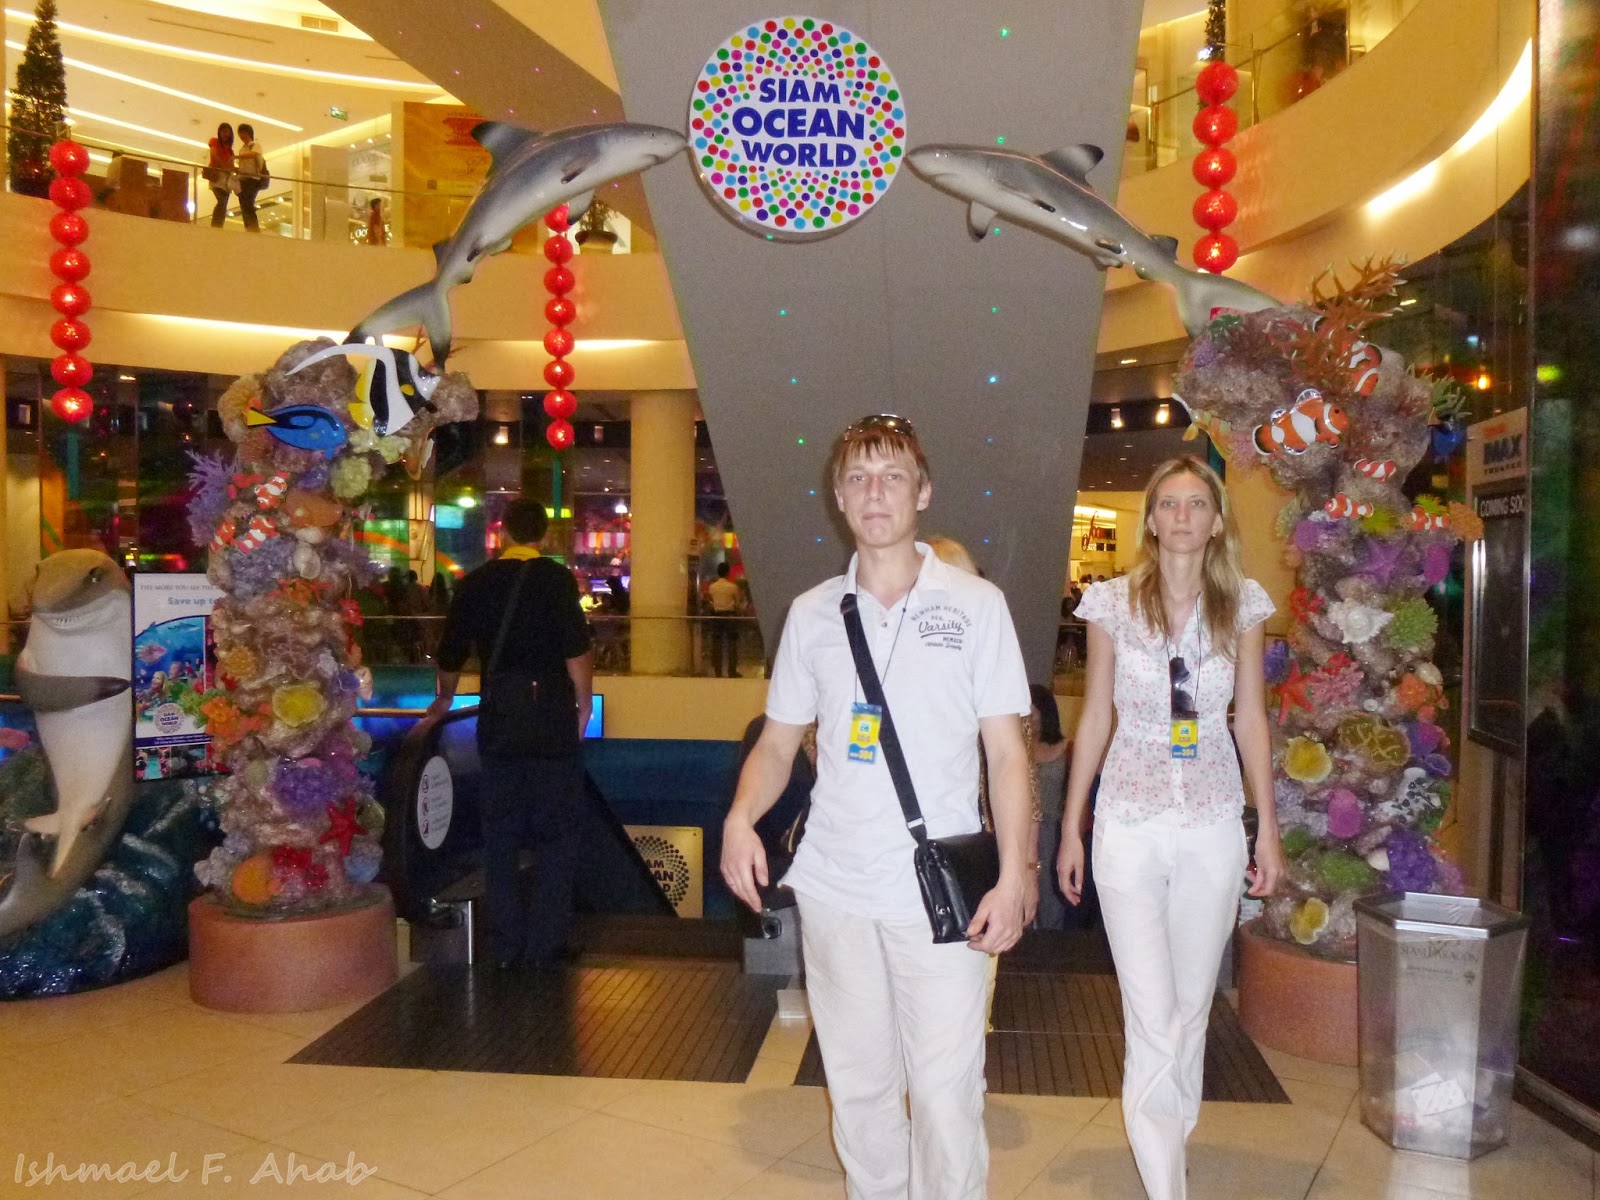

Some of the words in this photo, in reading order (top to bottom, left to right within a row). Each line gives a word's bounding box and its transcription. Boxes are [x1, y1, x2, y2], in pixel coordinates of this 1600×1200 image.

[758, 78, 841, 104] SIAM
[732, 107, 865, 140] OCEAN
[741, 139, 857, 167] WORLD
[1480, 497, 1509, 518] COMING
[1510, 494, 1527, 514] SOO
[167, 597, 191, 605] Save
[918, 619, 965, 639] Varsity
